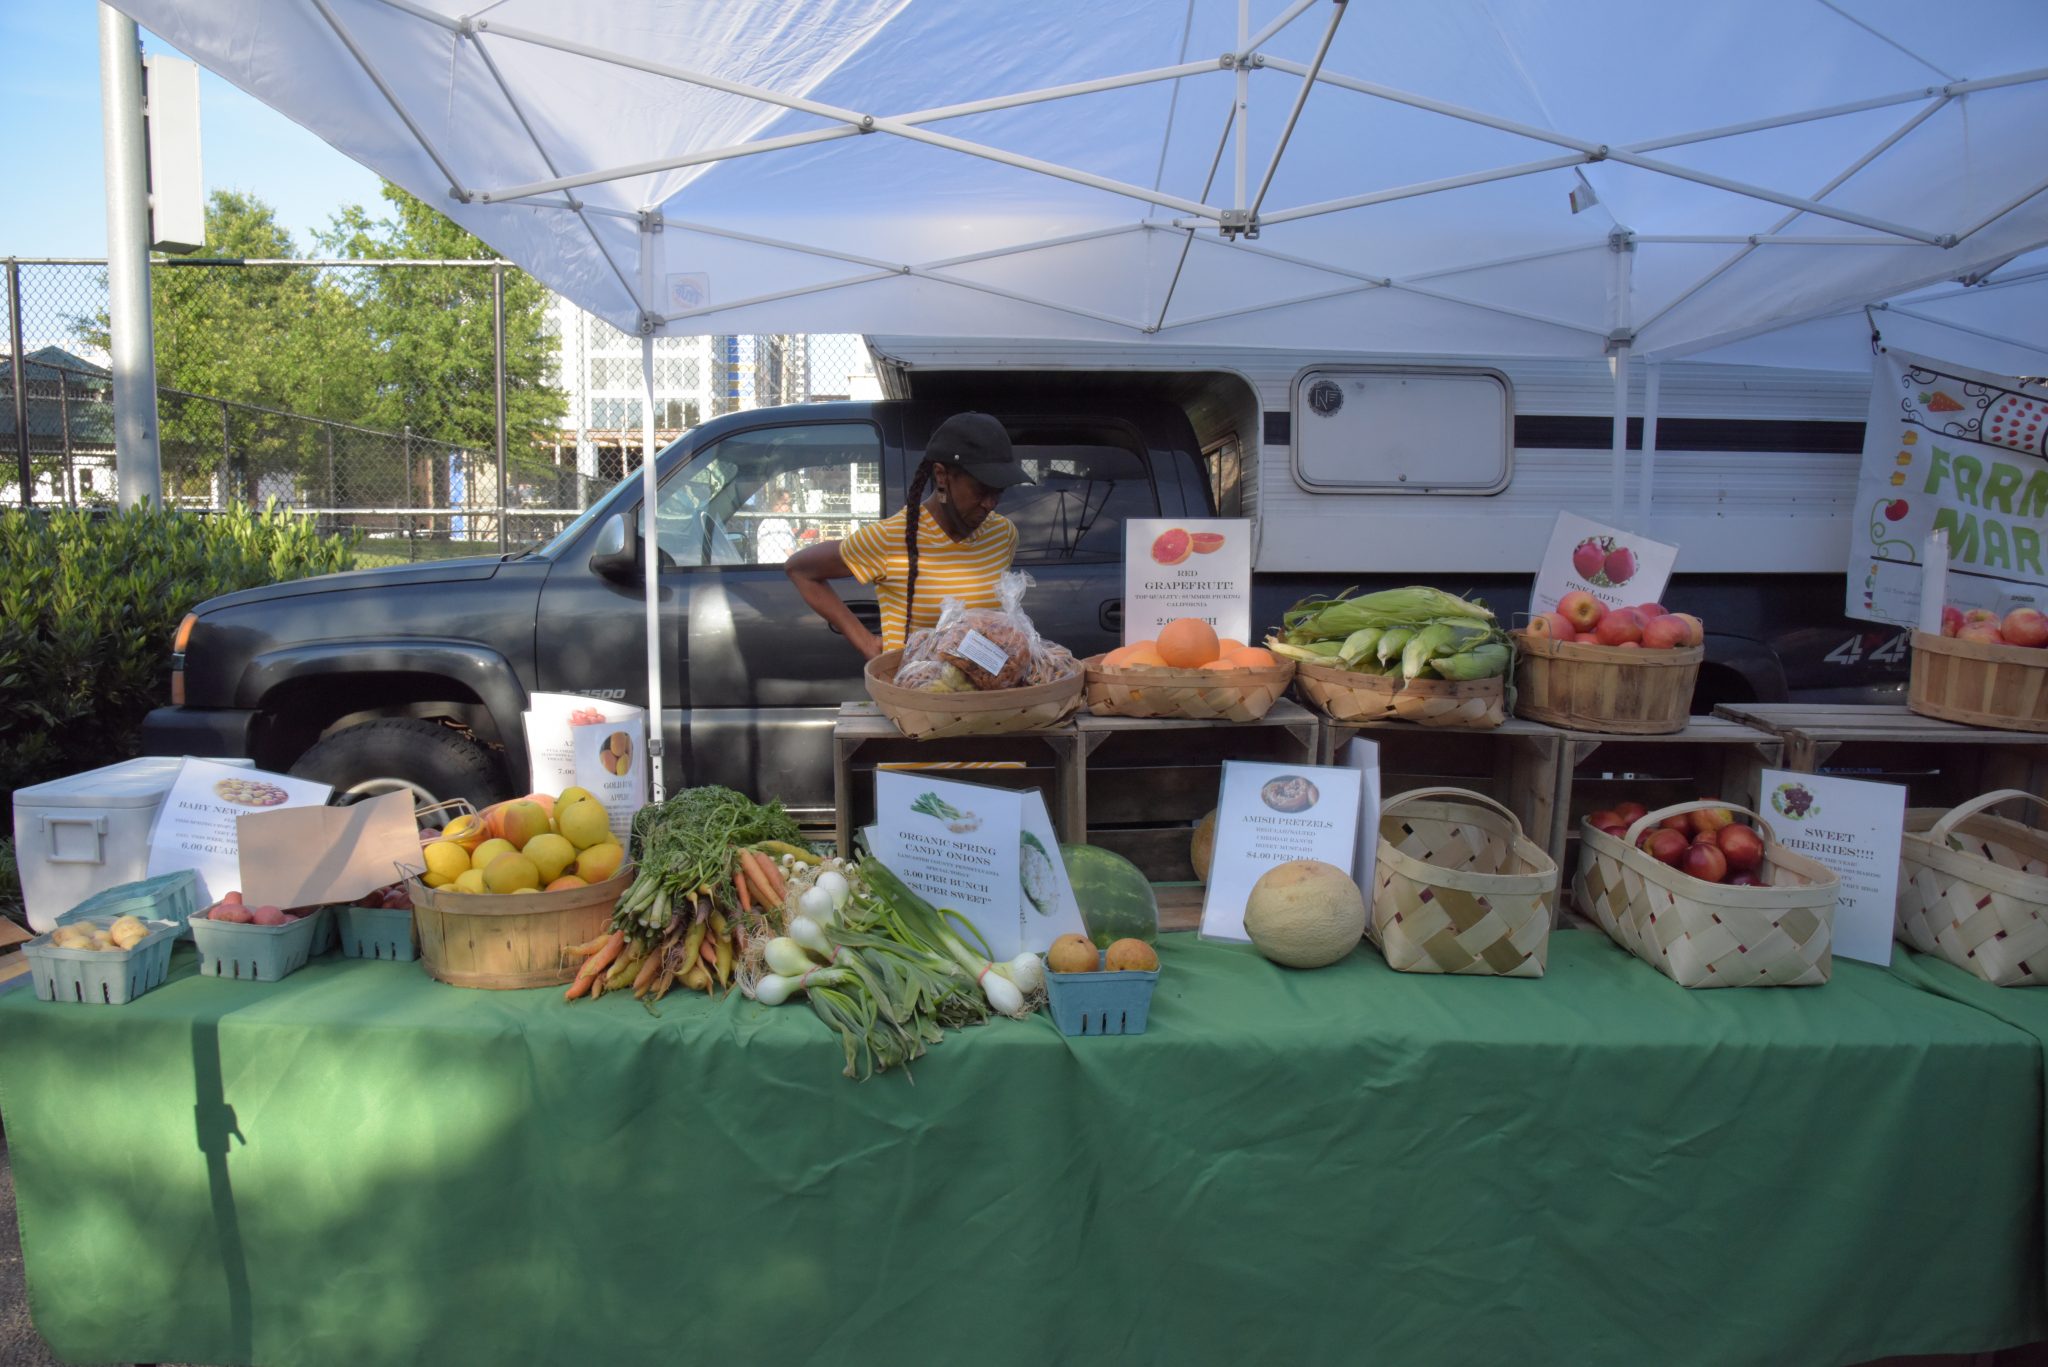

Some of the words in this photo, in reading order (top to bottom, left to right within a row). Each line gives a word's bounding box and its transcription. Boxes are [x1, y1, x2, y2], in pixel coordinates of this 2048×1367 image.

[1144, 581, 1234, 590] GRAPEFRUIT!
[178, 800, 211, 812] BABY
[212, 806, 241, 816] NEW
[1241, 815, 1276, 825] AMISH
[1278, 817, 1334, 829] PRETZELS
[1804, 827, 1856, 843] SWEET
[181, 841, 203, 851] 6.00
[204, 845, 239, 856] QUAR
[899, 831, 950, 847] ORGANIC
[952, 841, 997, 856] SPRING
[905, 843, 943, 857] CANDY
[946, 852, 991, 866] ONIONS
[903, 869, 923, 879] 3.00
[925, 873, 947, 884] PER
[949, 877, 989, 893] BUNCH
